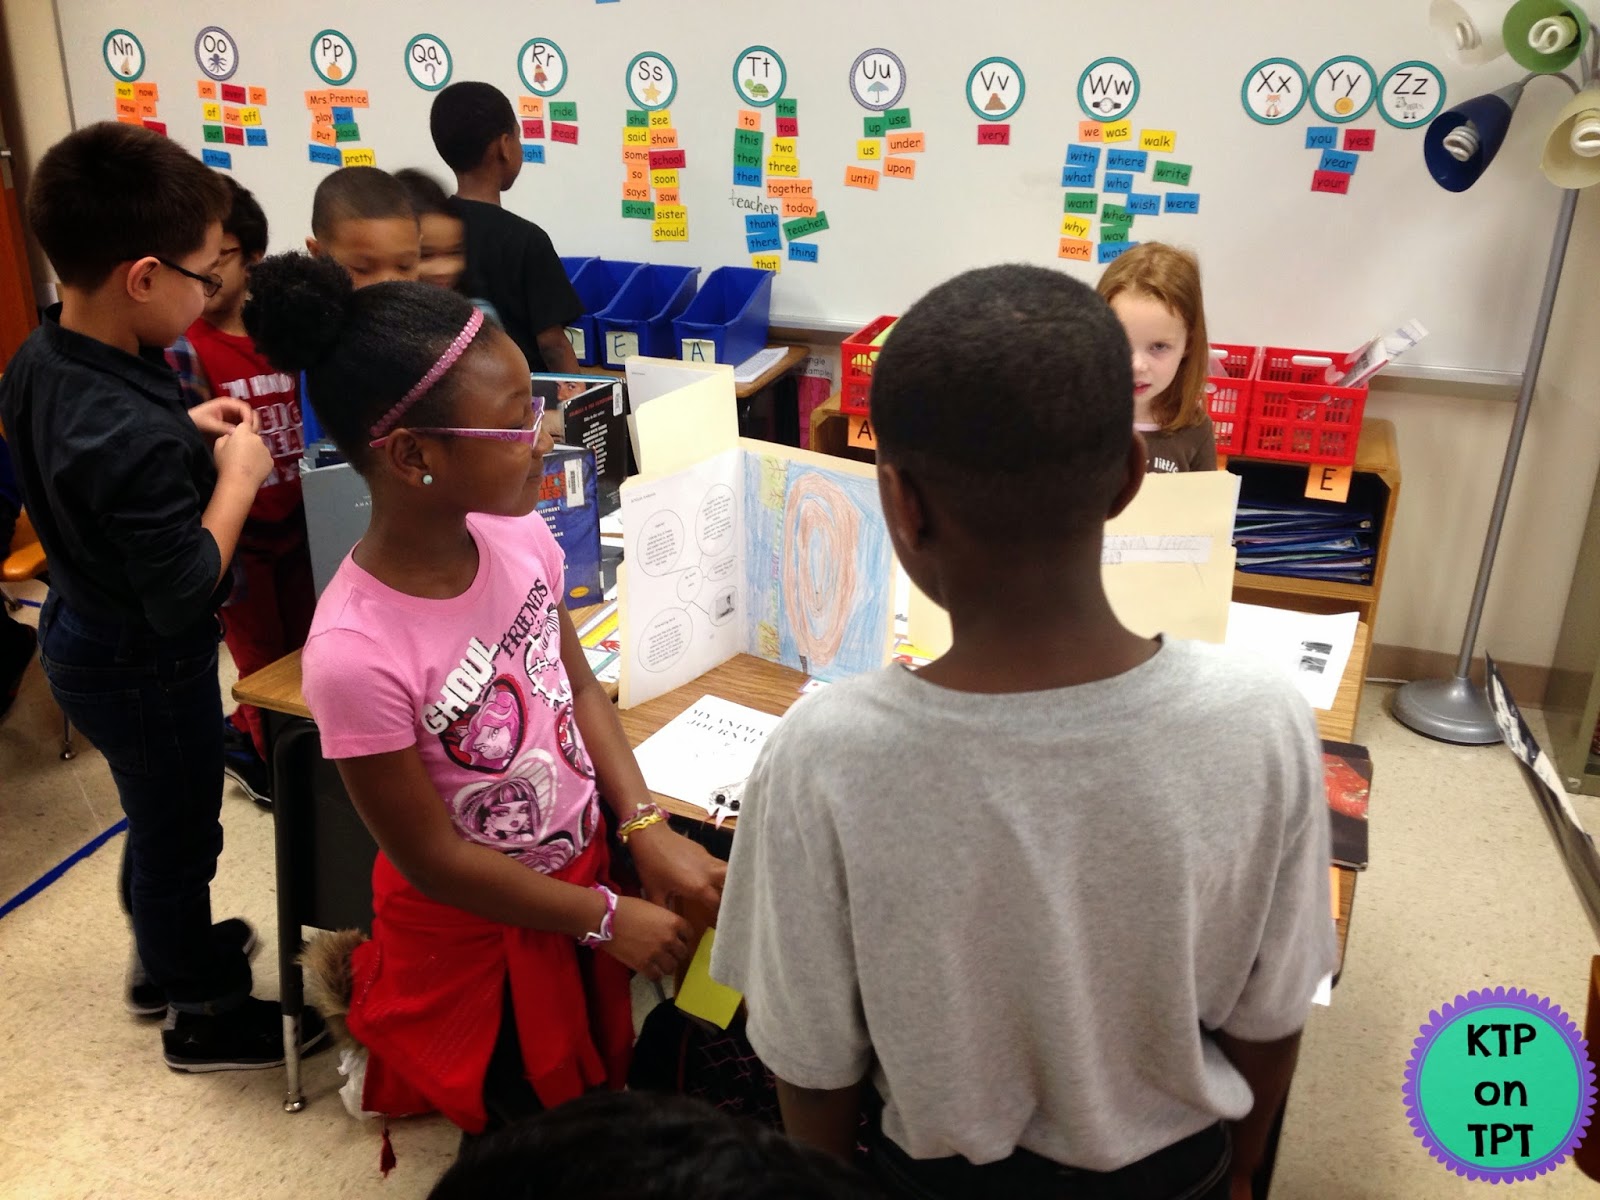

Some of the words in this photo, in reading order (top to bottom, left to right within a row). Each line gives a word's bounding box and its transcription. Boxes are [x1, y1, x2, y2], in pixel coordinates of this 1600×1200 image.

[112, 37, 134, 56] Nn
[203, 34, 227, 53] Oo
[322, 38, 344, 62] Pp
[412, 43, 442, 65] Qq
[531, 43, 555, 67] Rr
[638, 60, 664, 82] Ss
[746, 56, 770, 78] Tt
[862, 59, 891, 80] Uu
[980, 70, 1009, 91] Vv
[1088, 72, 1132, 96] Ww
[1256, 69, 1291, 94] Xx
[1326, 68, 1362, 98] Yy
[1393, 72, 1429, 96] Zz
[118, 88, 131, 96] not
[310, 95, 329, 105] Mrs.
[329, 92, 367, 104] Prentice
[120, 104, 135, 113] new
[143, 105, 152, 113] no
[207, 107, 216, 117] of
[523, 104, 539, 112] run
[553, 106, 573, 116] ride
[778, 103, 796, 114] the
[225, 112, 240, 121] our
[243, 111, 257, 122] off
[315, 111, 332, 124] play
[629, 114, 646, 125] she
[651, 117, 669, 126] see
[744, 116, 755, 126] to
[888, 115, 907, 126] use
[525, 125, 541, 134] red
[779, 123, 796, 133] too
[869, 124, 881, 135] up
[1084, 128, 1100, 137] we
[1106, 127, 1128, 138] was
[207, 131, 220, 139] out
[316, 130, 330, 140] put
[553, 129, 576, 140] read
[627, 131, 647, 142] said
[651, 133, 675, 144] show
[739, 134, 759, 146] this
[981, 129, 1008, 143] very
[890, 138, 921, 150] under
[1144, 135, 1171, 147] walk
[1310, 135, 1333, 148] you
[1348, 136, 1371, 148] yes
[774, 143, 793, 153] two
[863, 147, 875, 156] us
[344, 153, 373, 166] pretty
[524, 149, 543, 161] ight
[624, 151, 649, 161] some
[652, 153, 683, 165] school
[737, 152, 760, 167] they
[1070, 151, 1096, 164] with
[768, 161, 797, 173] three
[1108, 156, 1145, 167] where
[1324, 157, 1353, 169] year
[632, 171, 643, 179] so
[887, 164, 912, 175] upon
[1156, 168, 1189, 181] write
[654, 175, 676, 184] soon
[736, 171, 760, 182] then
[850, 174, 875, 185] until
[1064, 171, 1093, 183] what
[1106, 178, 1130, 189] who
[1316, 178, 1346, 189] your
[626, 188, 647, 200] says
[767, 183, 813, 197] together
[660, 193, 677, 202] saw
[728, 188, 779, 215] teacher
[625, 204, 651, 215] shout
[785, 202, 814, 216] today
[1068, 199, 1094, 209] want
[1130, 199, 1156, 210] wish
[1167, 199, 1196, 209] were
[656, 209, 685, 219] sister
[1103, 209, 1133, 222] when
[749, 219, 778, 229] thank
[786, 217, 825, 236] teacher
[1064, 221, 1087, 237] why
[654, 227, 685, 237] should
[750, 237, 778, 248] there
[790, 248, 816, 260] thing
[1062, 245, 1089, 256] work
[1102, 248, 1126, 259] wat
[756, 259, 777, 269] that
[614, 334, 627, 358] E
[691, 341, 705, 362] A
[857, 420, 873, 441] A
[1153, 456, 1180, 473] little
[1320, 467, 1337, 492] E
[420, 636, 500, 736] GHOUL
[500, 577, 550, 661] FRIENDS
